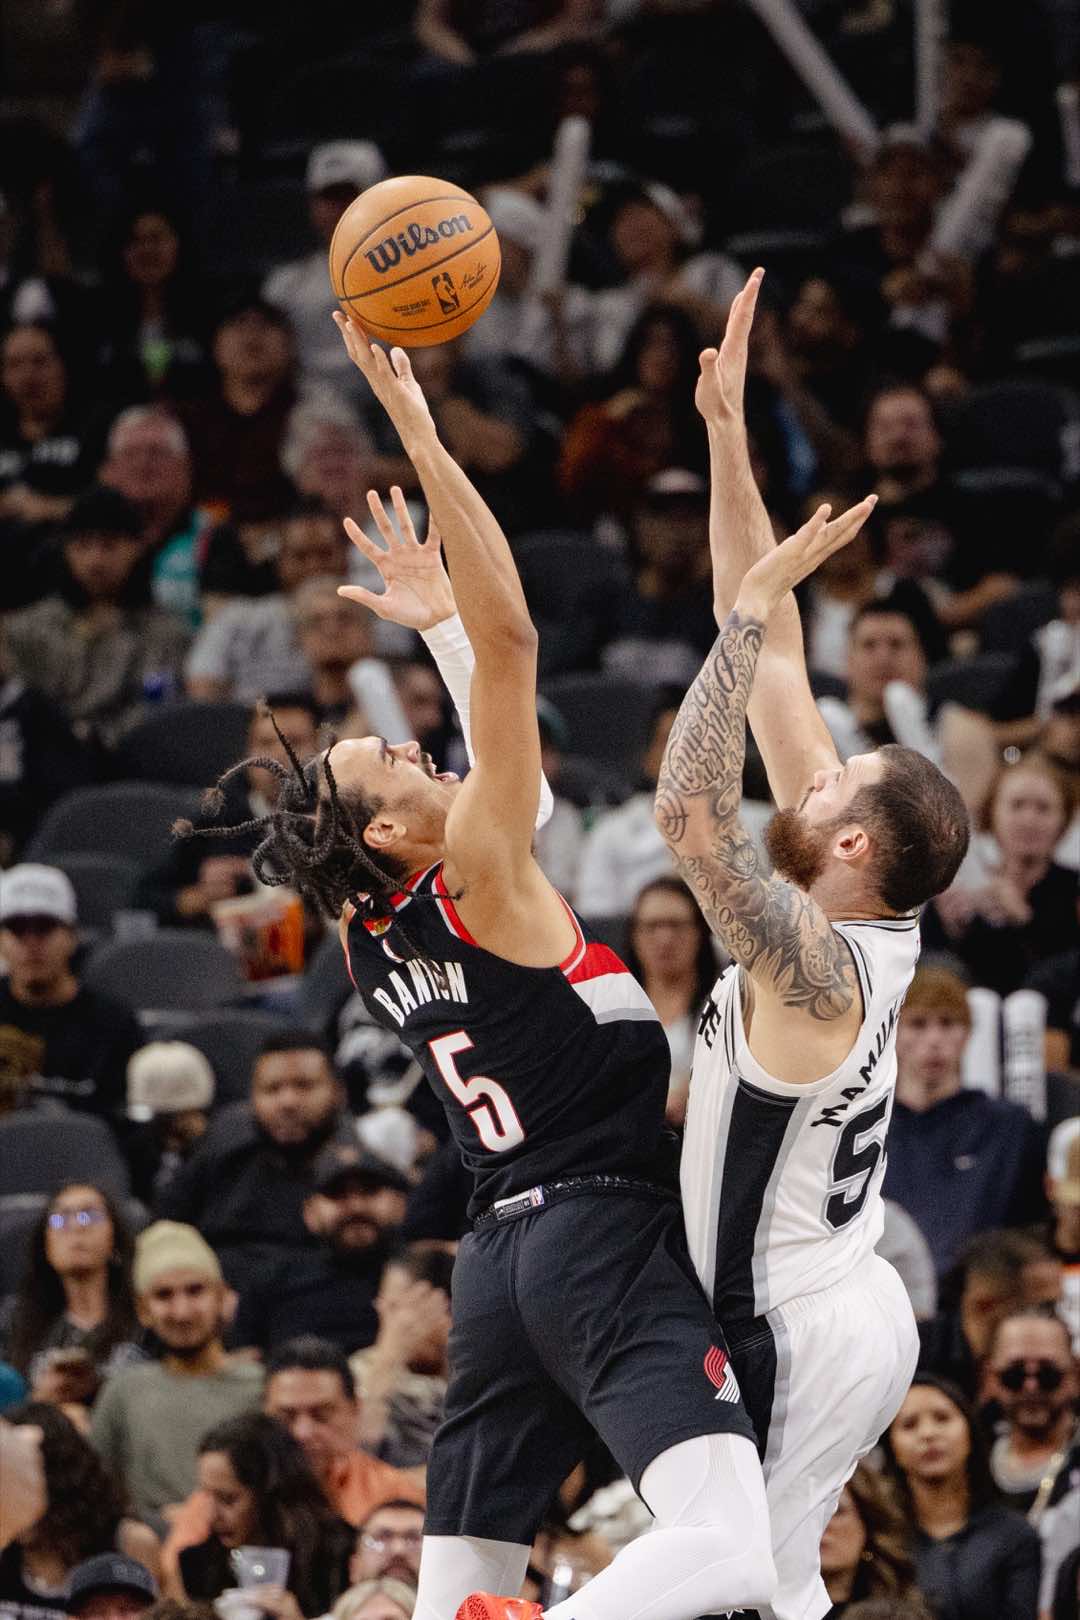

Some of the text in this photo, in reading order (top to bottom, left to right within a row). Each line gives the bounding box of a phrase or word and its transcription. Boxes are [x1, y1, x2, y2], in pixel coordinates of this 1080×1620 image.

[365, 214, 472, 274] Wilson
[428, 1031, 526, 1154] 5
[823, 1091, 890, 1232] 5
